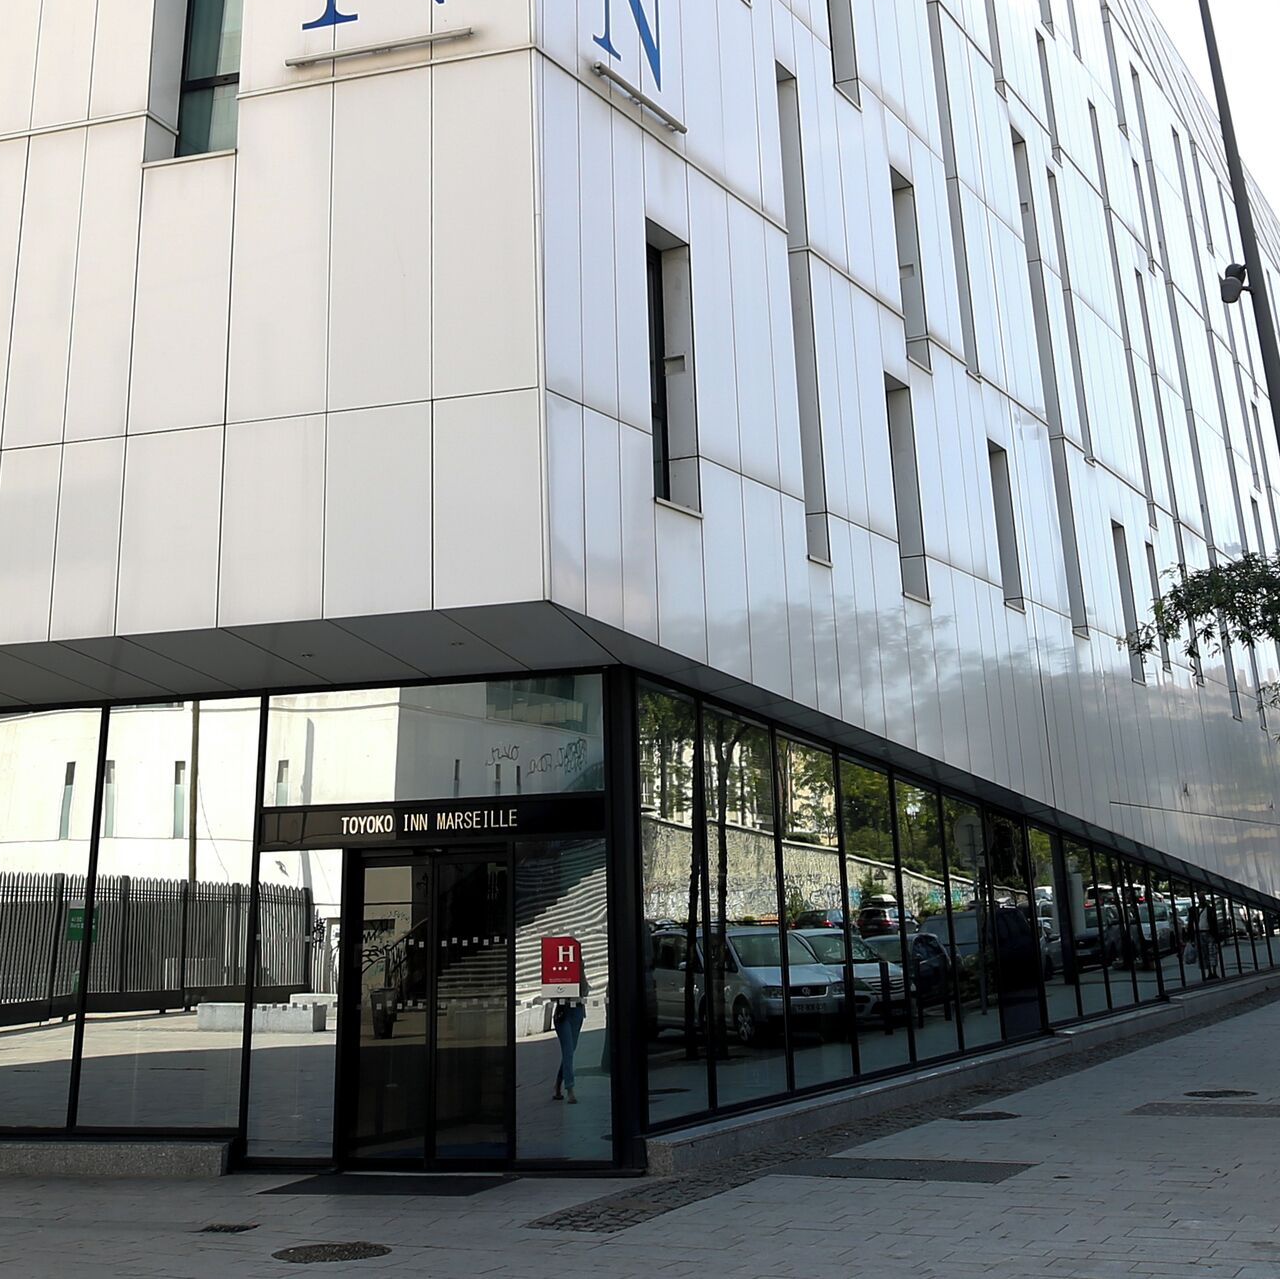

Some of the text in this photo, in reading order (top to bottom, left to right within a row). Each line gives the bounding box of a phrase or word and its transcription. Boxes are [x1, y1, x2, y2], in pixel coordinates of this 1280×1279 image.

[341, 809, 518, 835] TOYOKO INN MARSEILLE
[557, 945, 575, 963] H
